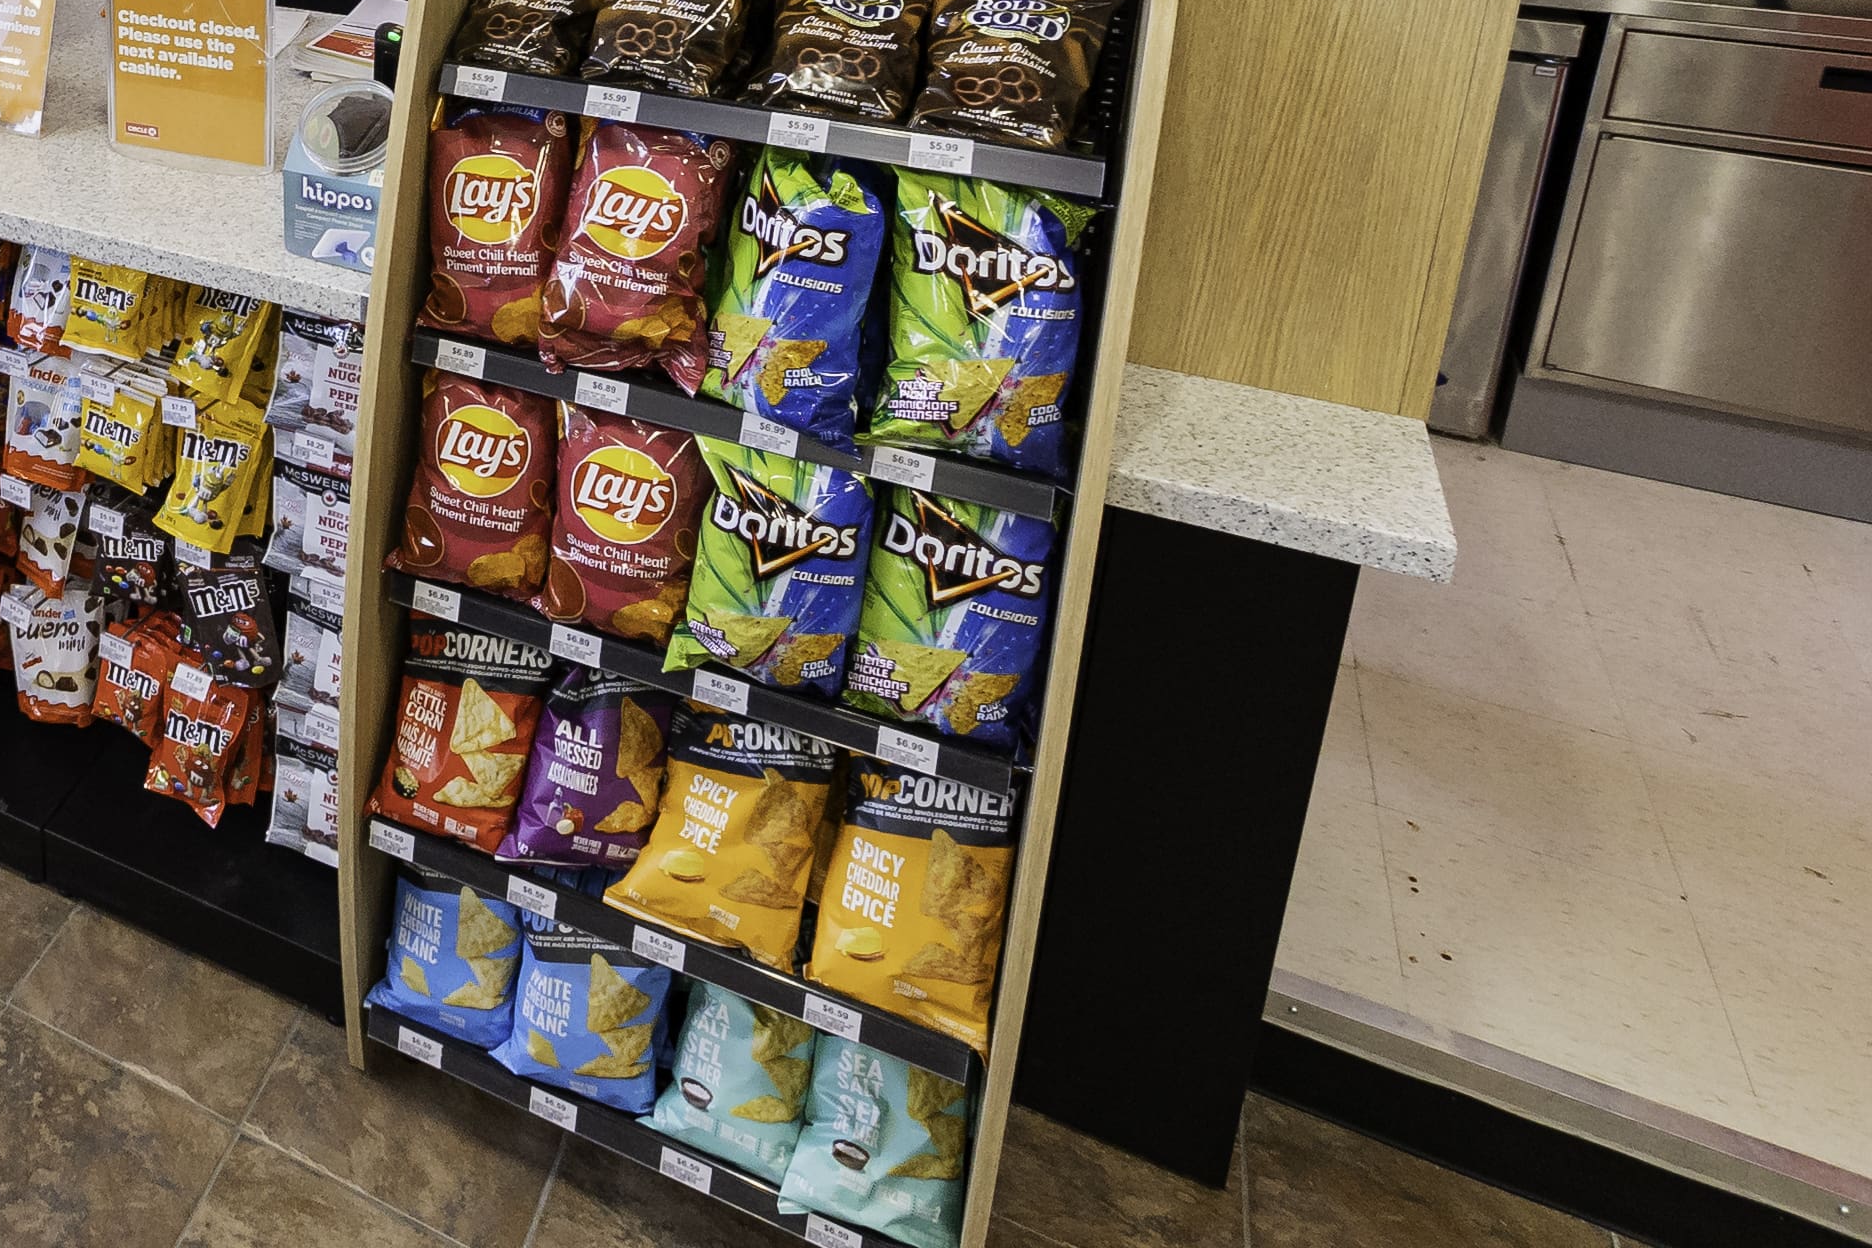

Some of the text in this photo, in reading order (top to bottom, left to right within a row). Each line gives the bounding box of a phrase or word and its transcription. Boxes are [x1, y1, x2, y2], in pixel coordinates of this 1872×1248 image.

[118, 9, 260, 41] Checkout closed.
[803, 16, 845, 31] Classic
[966, 10, 1064, 41] GOLD
[118, 26, 235, 55] Please use the
[118, 44, 234, 71] next available
[118, 60, 182, 81] cashier.
[471, 72, 495, 84] $5.99
[602, 92, 627, 103] $5.99
[787, 120, 815, 133] $5.99
[929, 140, 959, 153] $5.99
[302, 176, 373, 210] hippos
[450, 174, 533, 224] Lay's
[585, 180, 679, 239] Lay's
[742, 195, 848, 265] Doritos
[443, 246, 539, 263] Sweet Chili Heat!
[446, 259, 538, 276] Piment infernal!
[914, 230, 1076, 291] Doritos
[614, 275, 668, 296] infernal!
[636, 268, 668, 284] Heat!
[773, 271, 844, 295] COLLISIONS
[1010, 305, 1076, 321] COLLISIONS
[451, 346, 474, 359] $6.89
[592, 381, 617, 394] $6.89
[785, 368, 814, 379] COOL
[759, 420, 786, 436] $6.99
[440, 420, 525, 478] Lay's
[891, 453, 921, 469] $6.99
[430, 487, 525, 519] Sweet Chili Heat!
[577, 463, 670, 523] Lay's
[430, 501, 521, 533] Piment infernal!
[713, 493, 857, 557] Doritos
[566, 534, 669, 569] Sweet Chili Heat!
[884, 512, 1045, 596] Doritos
[791, 570, 856, 586] COLLISIONS
[967, 601, 1039, 627] COLLISIONS
[802, 659, 830, 671] COOL
[854, 663, 890, 679] PICKLE
[409, 686, 448, 716] KETTLE
[710, 678, 737, 694] $6.99
[405, 702, 444, 732] CORN
[554, 720, 603, 749] ALL
[895, 735, 925, 753] $6.99
[554, 736, 603, 770] DRESSED
[689, 773, 738, 808] SPICY
[683, 795, 729, 830] CHEDDAR
[850, 836, 906, 878] SPICY
[846, 861, 901, 903] CHEDDAR
[404, 893, 443, 929] WHITE
[841, 883, 898, 929] ÉPICÉ
[400, 911, 441, 947] CHEDDAR
[397, 927, 439, 965] BLANC
[530, 968, 572, 1000] WHITE
[526, 983, 571, 1019] CHEDDAR
[522, 998, 568, 1038] BLANC
[838, 1048, 884, 1082] SEA
